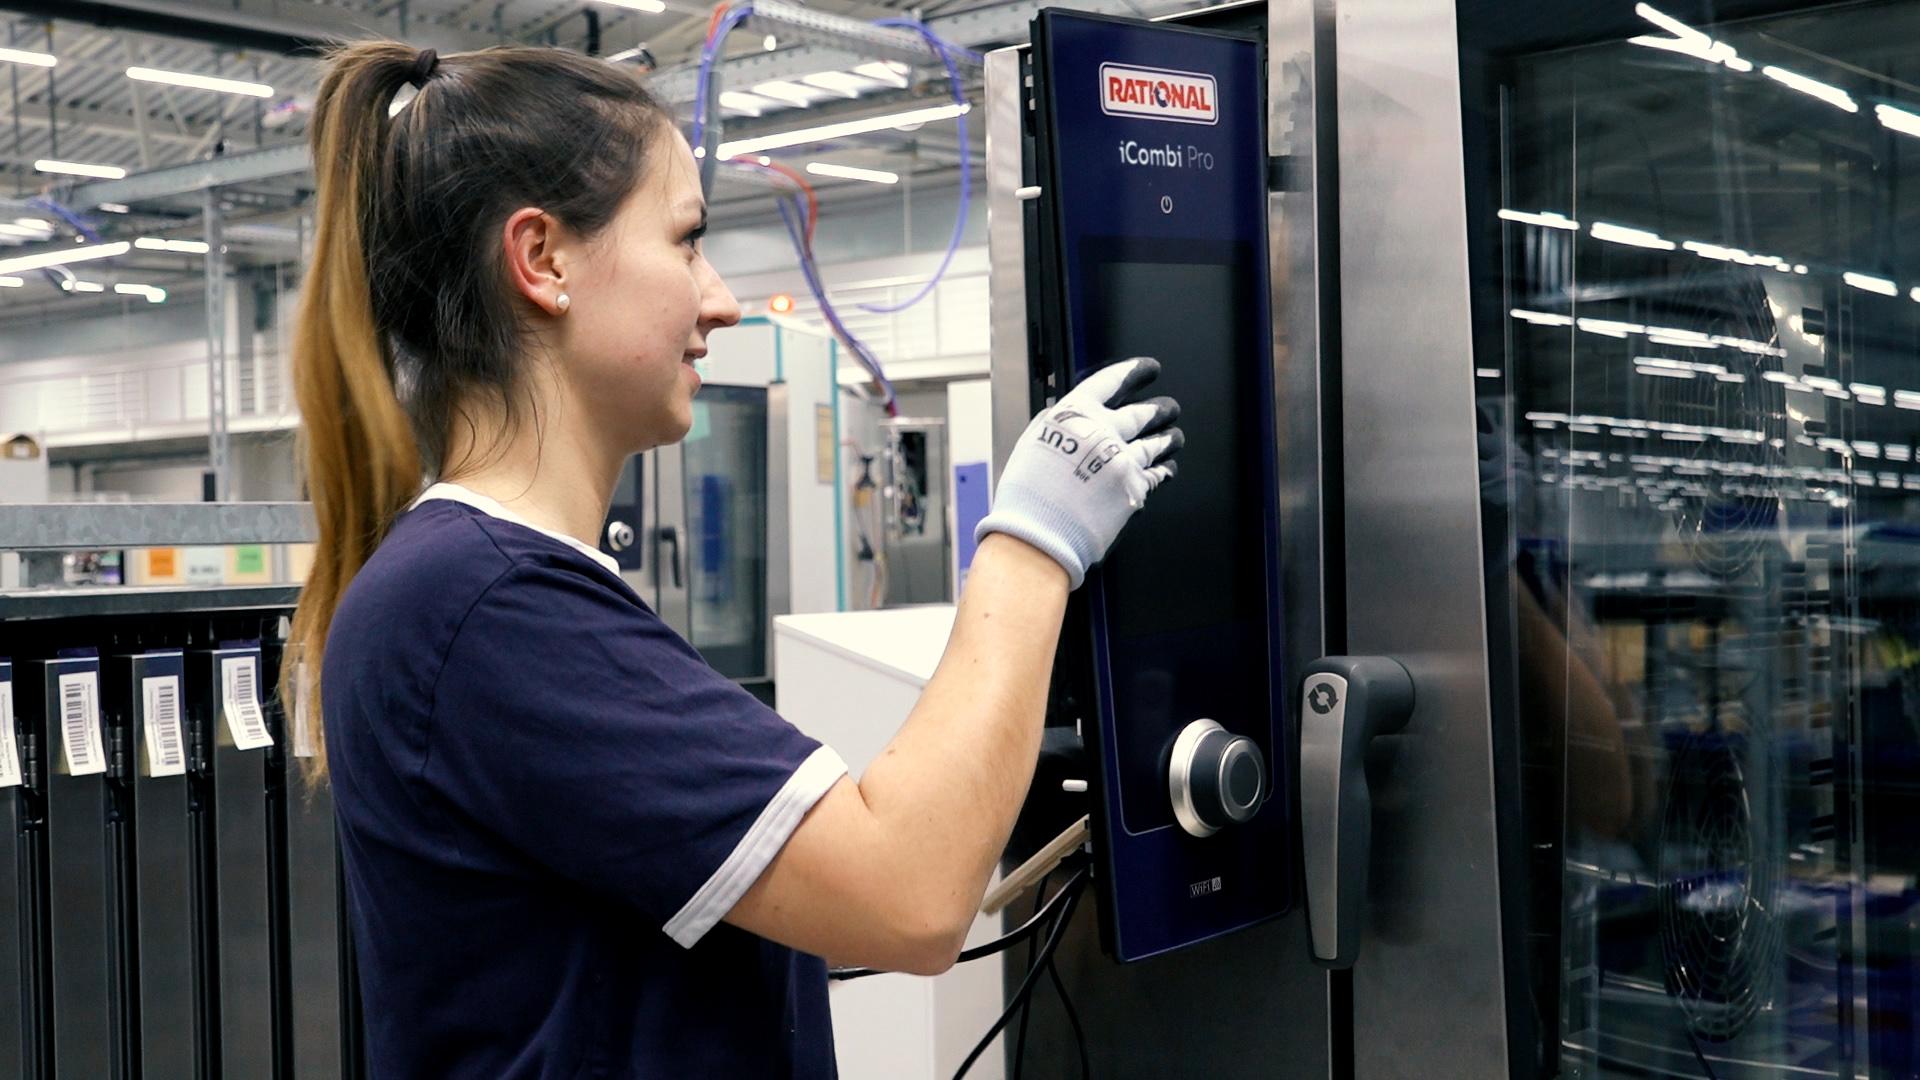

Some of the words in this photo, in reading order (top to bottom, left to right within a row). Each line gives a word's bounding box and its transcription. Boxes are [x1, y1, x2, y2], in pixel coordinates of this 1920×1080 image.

[1108, 76, 1211, 111] RATIONAL
[1119, 140, 1182, 167] iCombi
[1187, 146, 1214, 170] Pro
[1038, 427, 1079, 455] CUT
